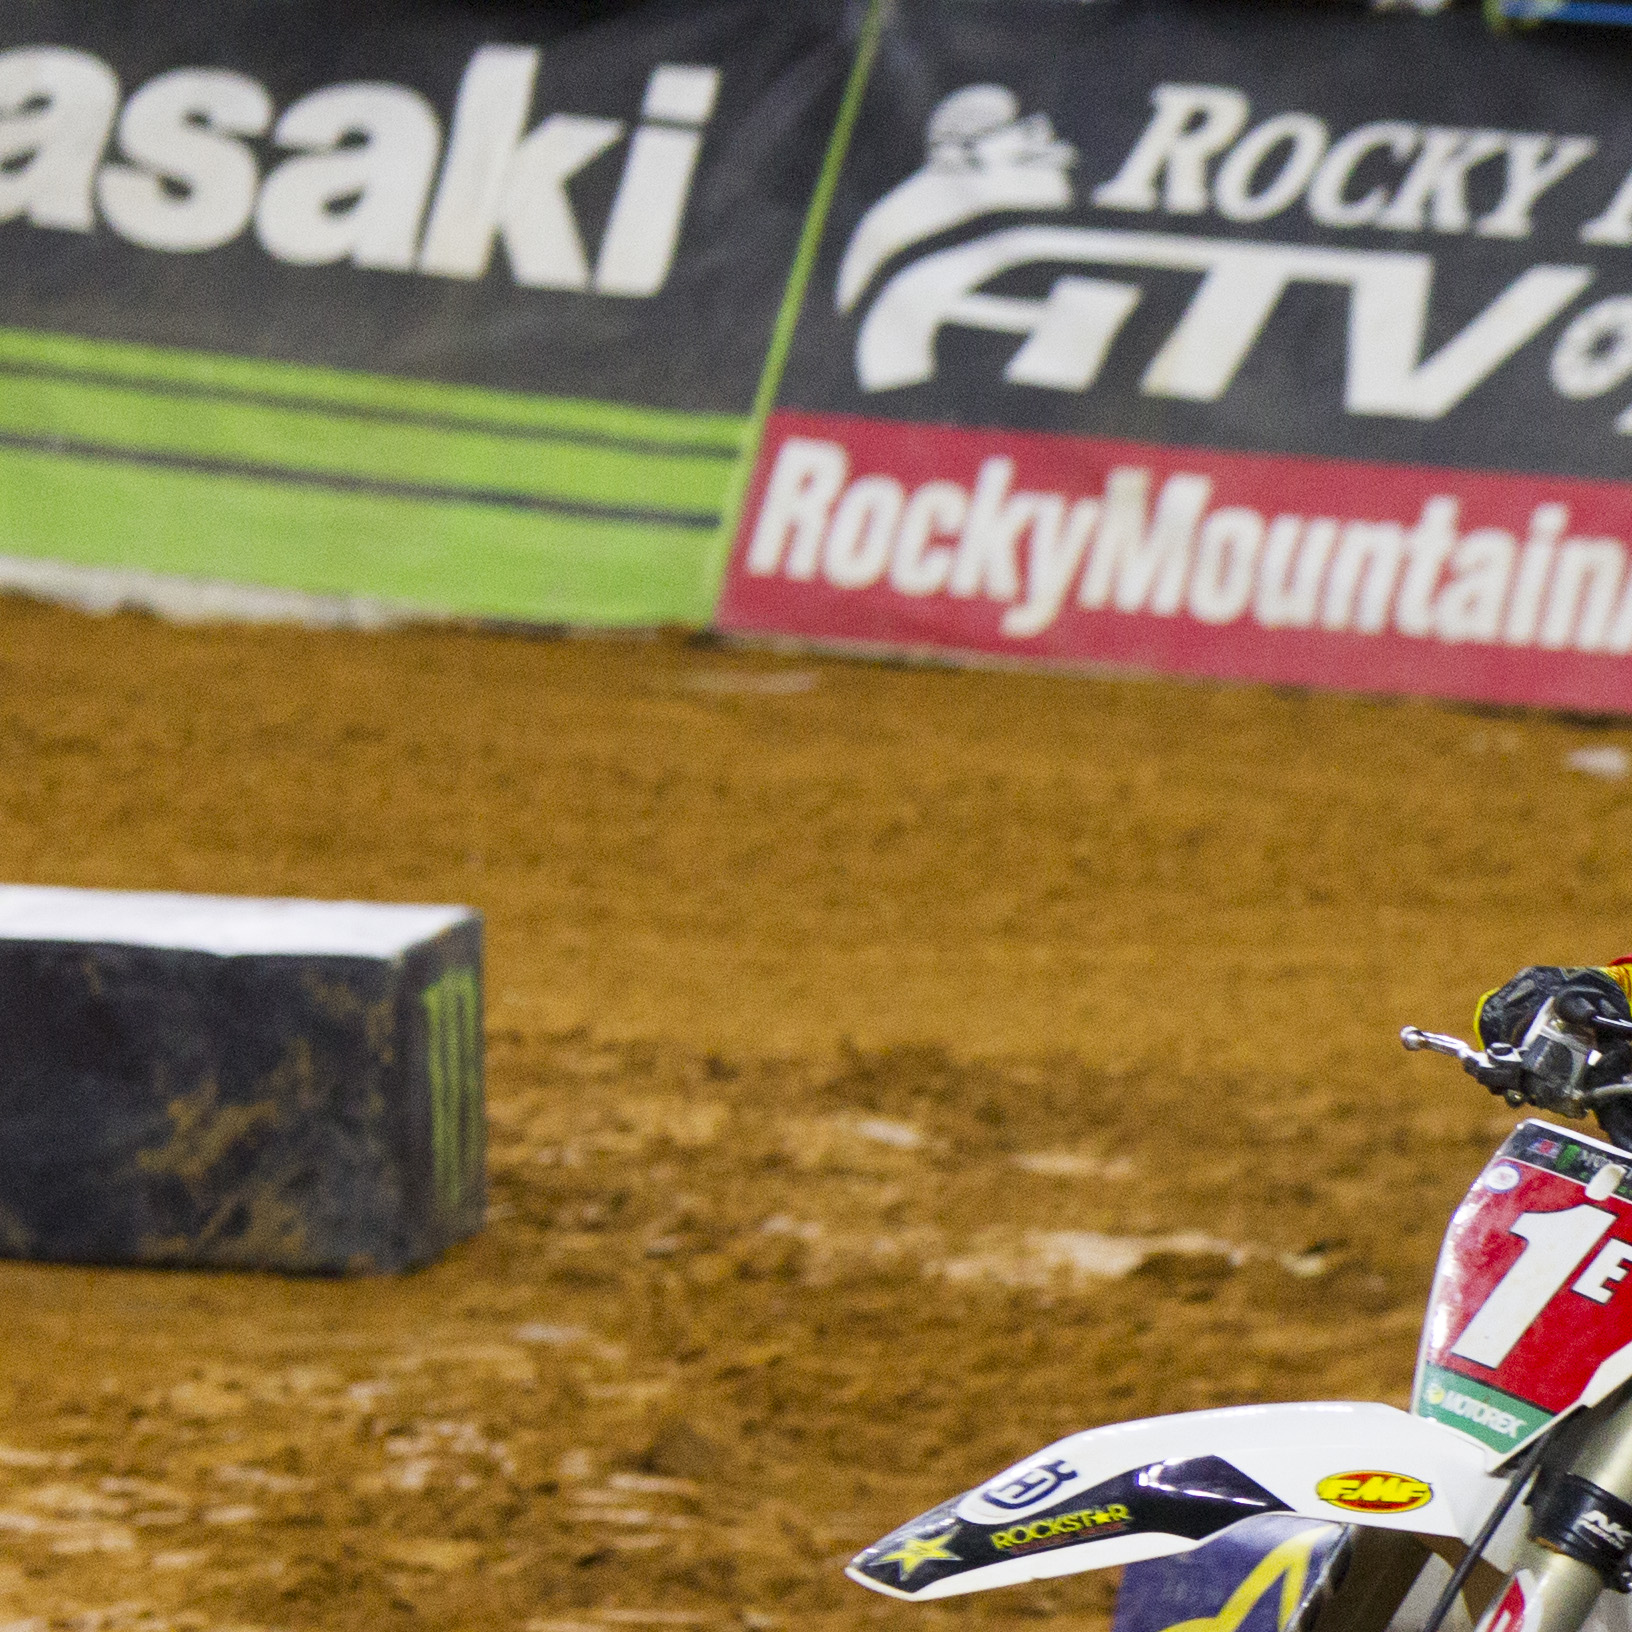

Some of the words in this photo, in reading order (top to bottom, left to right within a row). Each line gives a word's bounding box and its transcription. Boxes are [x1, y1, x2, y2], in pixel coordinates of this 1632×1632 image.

[1090, 82, 1598, 240] ROCKY
[855, 224, 1600, 420] ATV
[1442, 1388, 1526, 1441] MOTOREX
[1318, 1475, 1430, 1504] FMF
[990, 1503, 1130, 1553] ROCKSTAR
